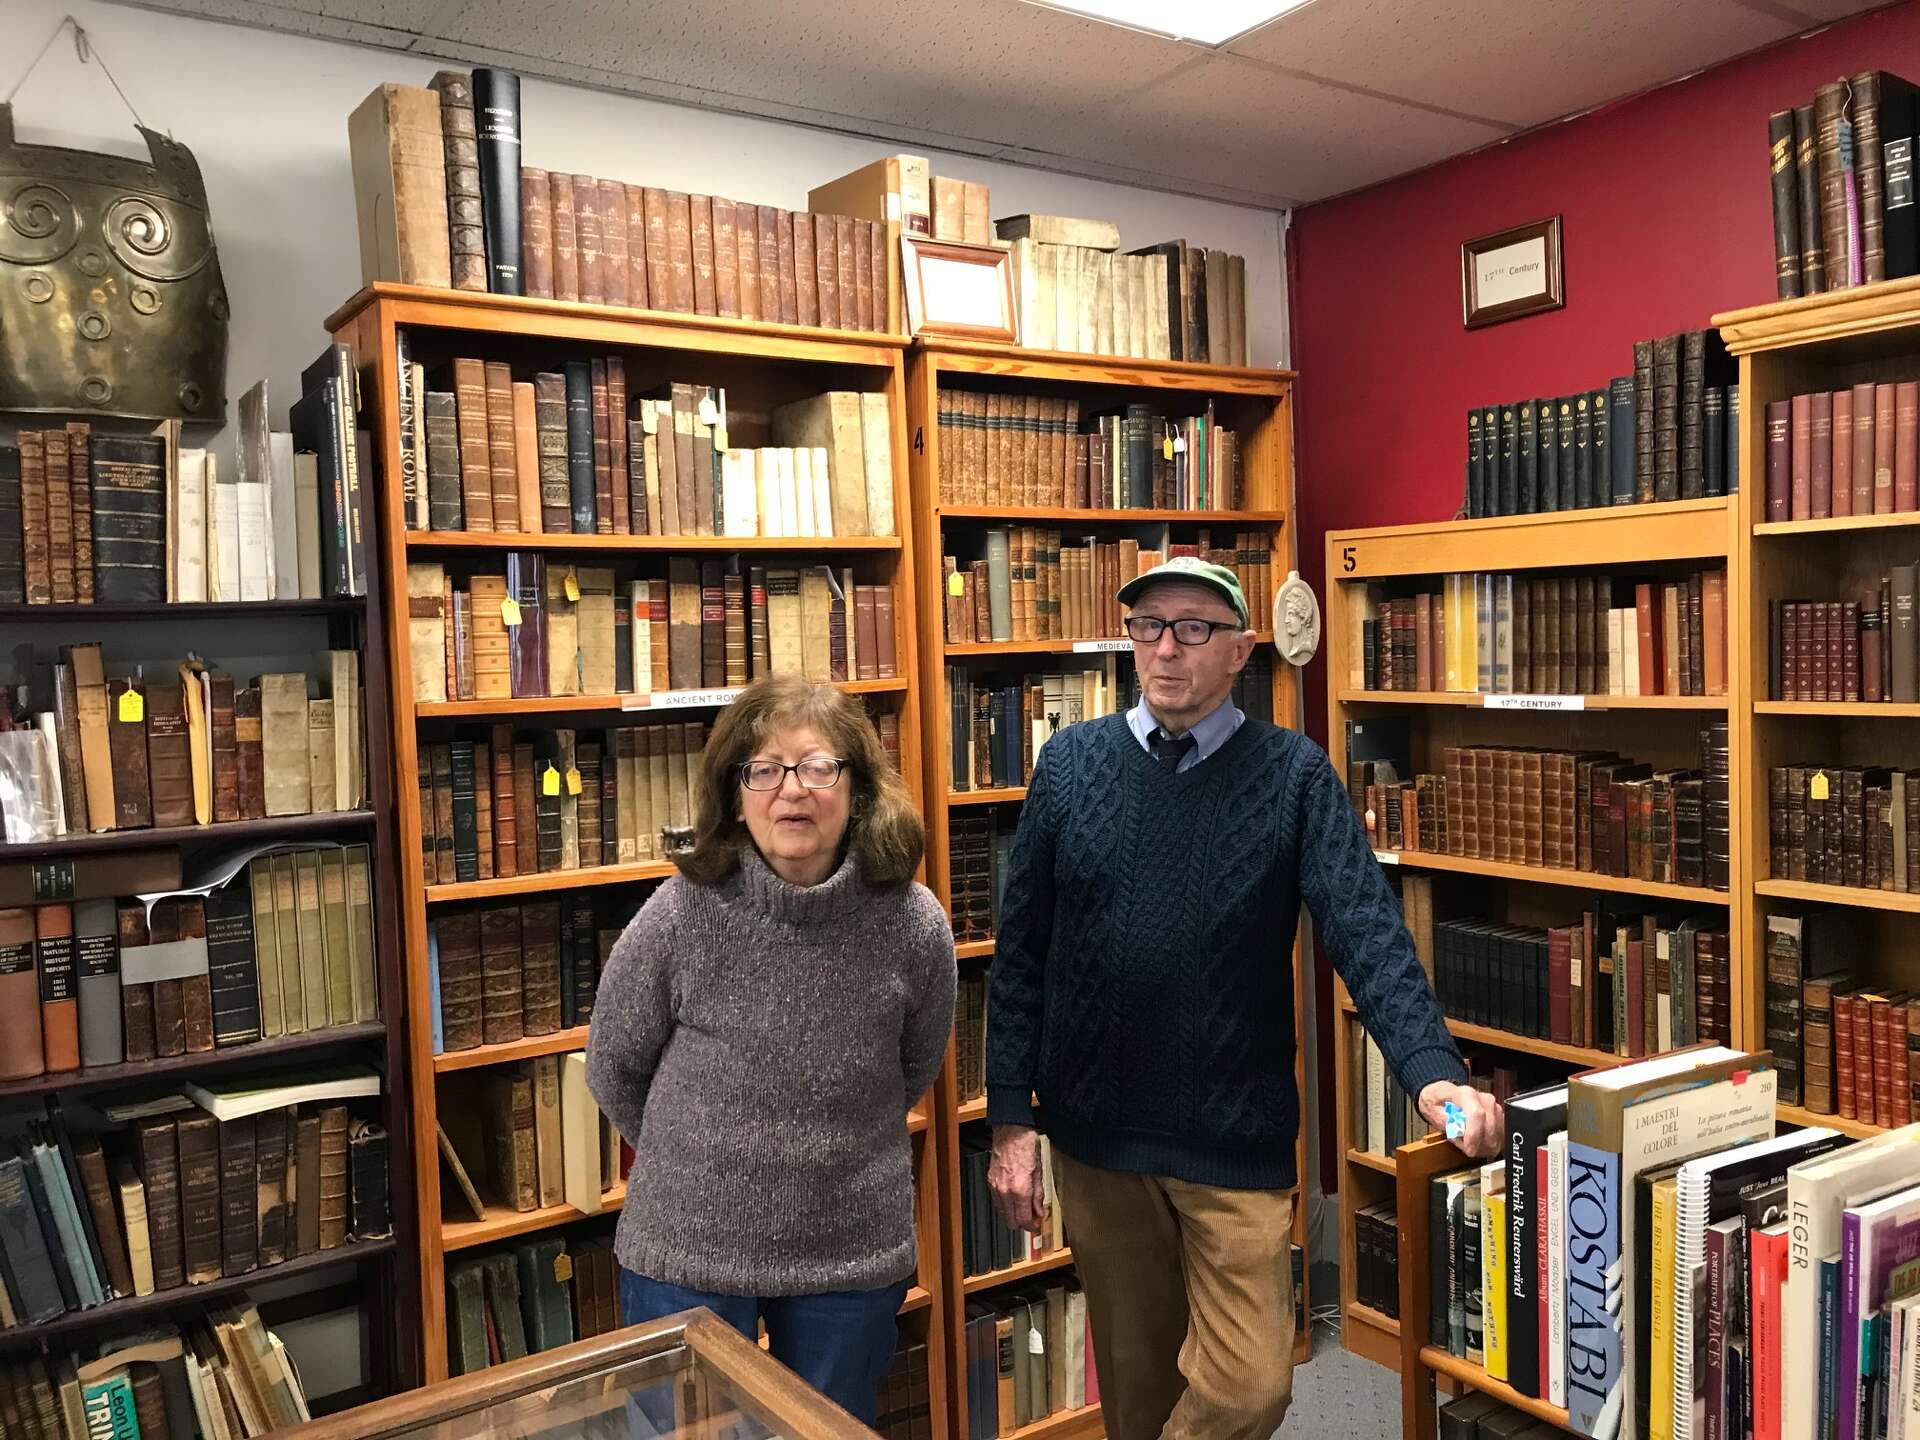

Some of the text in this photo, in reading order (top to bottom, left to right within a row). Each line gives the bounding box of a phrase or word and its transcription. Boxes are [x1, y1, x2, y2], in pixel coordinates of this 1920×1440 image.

[1509, 262, 1540, 276] Century
[344, 406, 355, 445] COLLEGE
[401, 359, 417, 502] ANCIENT ROME
[914, 426, 924, 455] 4
[347, 446, 358, 492] FOOTBALL
[1344, 547, 1356, 572] 5
[666, 695, 712, 705] ANCIENT
[1520, 700, 1562, 708] CENTURY
[43, 948, 70, 956] NATURAL
[45, 956, 70, 964] HISTORY
[45, 965, 72, 973] REPORTS
[1760, 1082, 1772, 1094] 210
[1640, 1106, 1679, 1129] MAESTRI
[1662, 1121, 1679, 1136] DEL
[1643, 1135, 1678, 1155] COLORE
[1512, 1131, 1526, 1298] Carl Fredrik Reuterswärd
[1537, 1197, 1548, 1233] HASKIL
[1792, 1200, 1808, 1270] LEGER
[1538, 1236, 1548, 1270] CLARA
[1569, 1152, 1608, 1404] KOSTABI
[1652, 1200, 1663, 1339] THE BEST OF BEARDSLEY
[1711, 1251, 1720, 1295] PORTRAITS
[1708, 1308, 1720, 1368] PLACES
[111, 1384, 128, 1427] Leon
